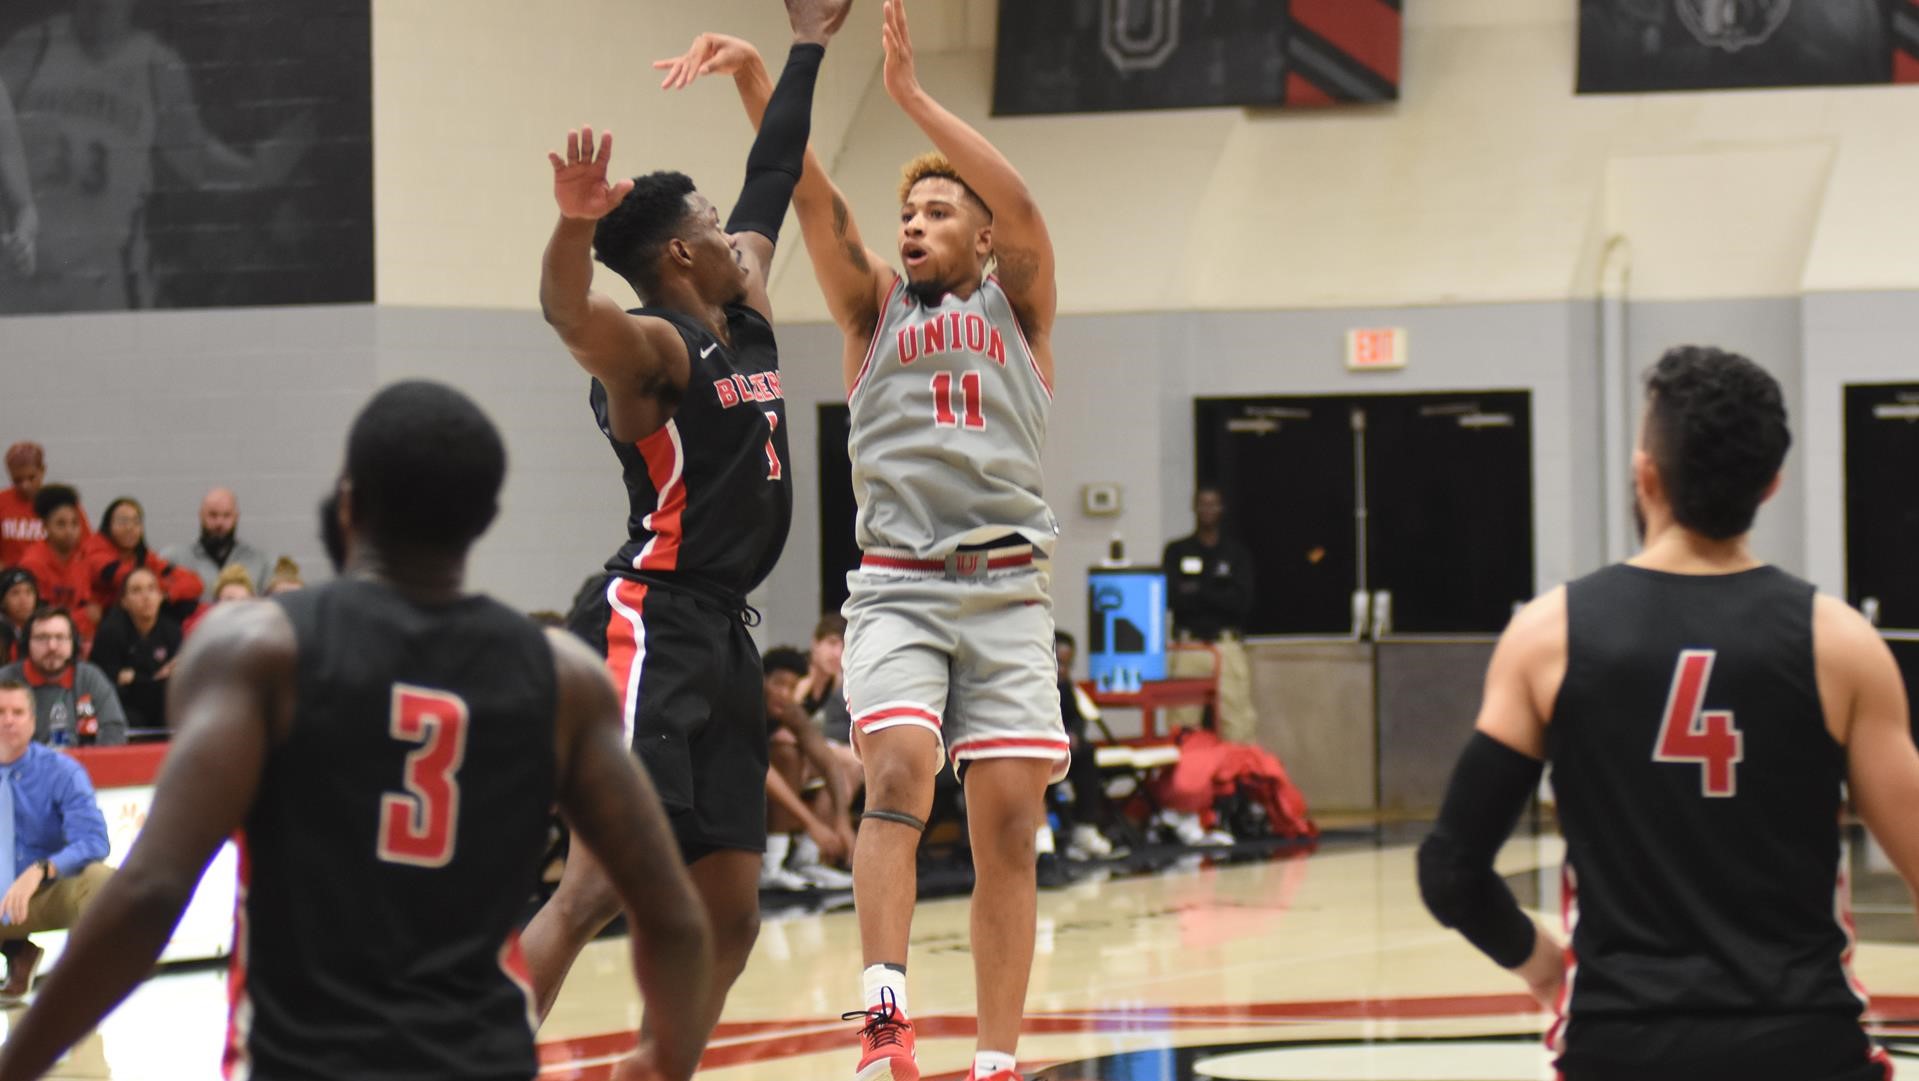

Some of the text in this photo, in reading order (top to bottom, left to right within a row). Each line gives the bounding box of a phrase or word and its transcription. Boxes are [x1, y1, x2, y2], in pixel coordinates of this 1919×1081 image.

[896, 311, 1007, 367] UNION
[929, 370, 986, 432] 11
[377, 682, 469, 869] 3
[1652, 649, 1744, 798] 4
